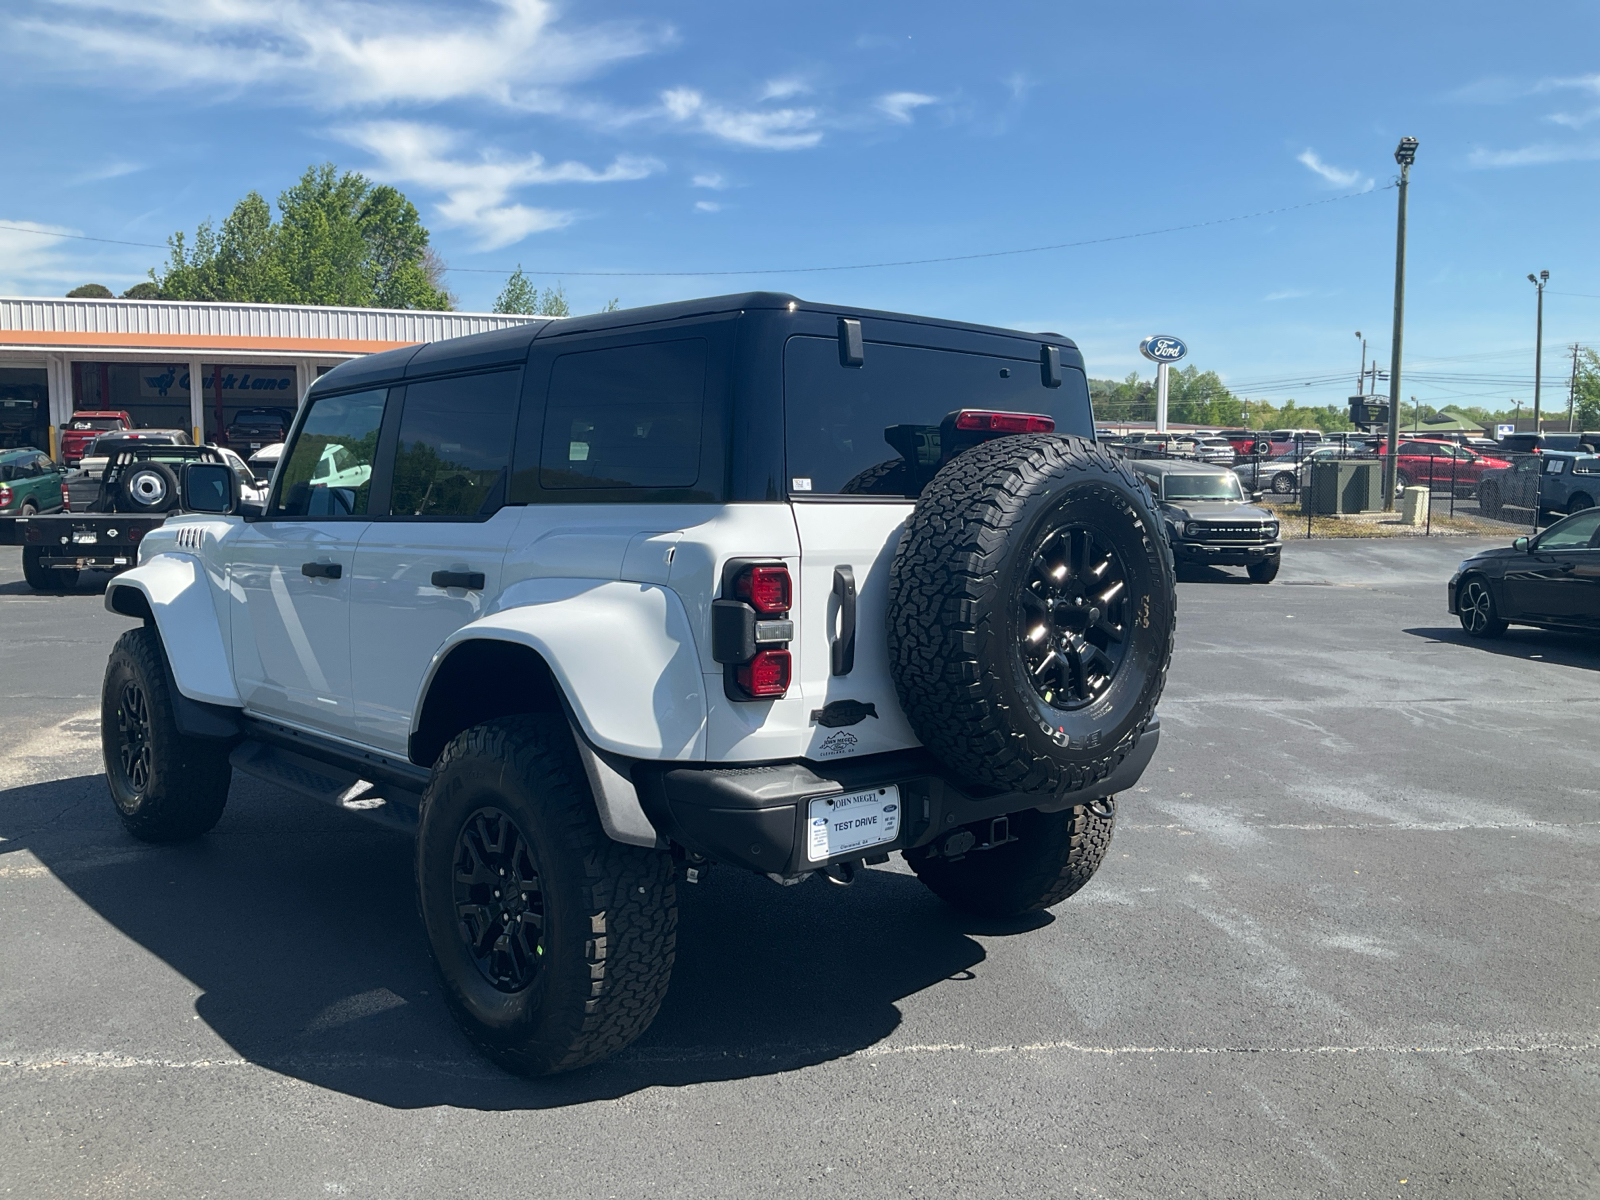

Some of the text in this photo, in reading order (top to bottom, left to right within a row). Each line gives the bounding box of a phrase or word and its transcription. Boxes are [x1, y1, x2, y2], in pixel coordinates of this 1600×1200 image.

[1154, 340, 1180, 357] Ford
[179, 372, 291, 391] Quik Lane
[832, 793, 878, 811] JOHN MEGEL
[834, 820, 854, 832] TEST
[855, 816, 878, 828] DRIVE
